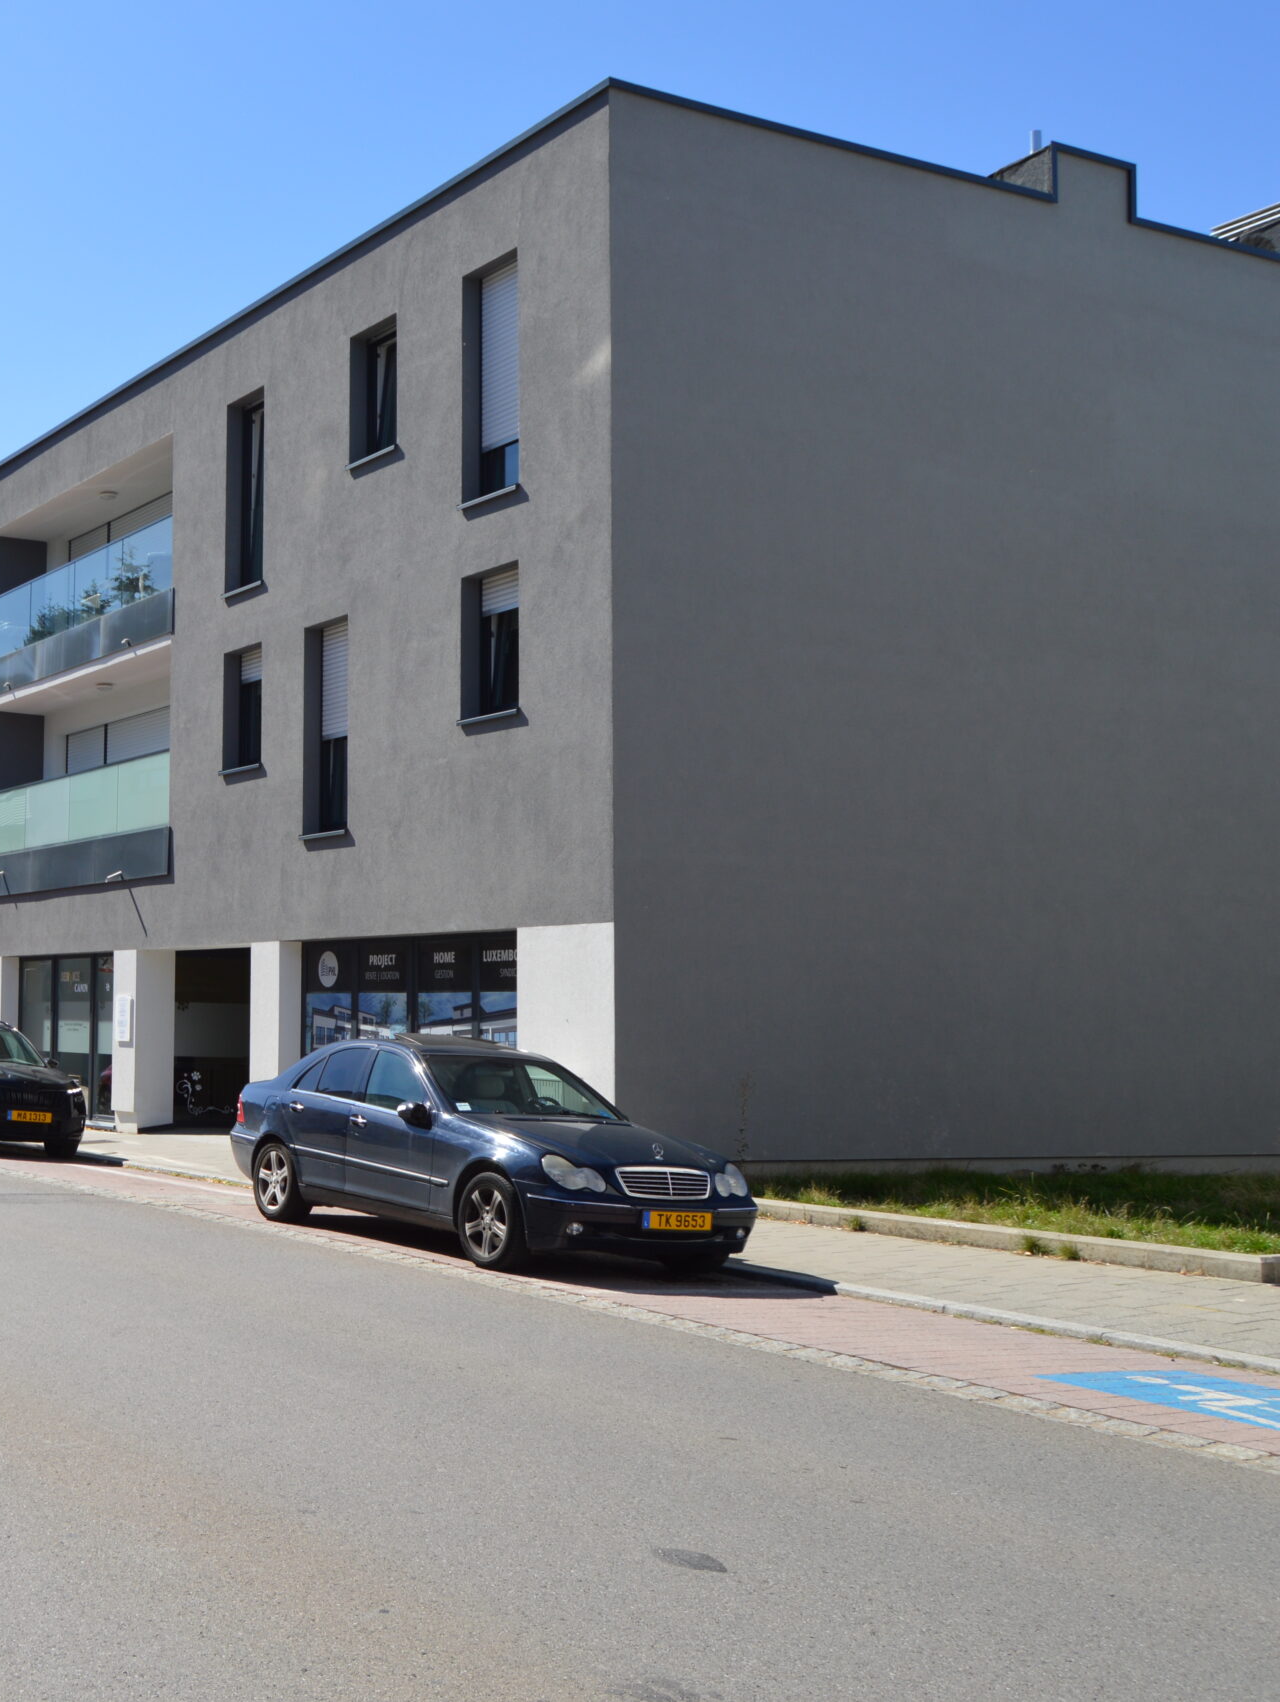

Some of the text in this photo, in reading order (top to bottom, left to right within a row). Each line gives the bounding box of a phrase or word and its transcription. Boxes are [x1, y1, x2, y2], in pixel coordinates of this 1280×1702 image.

[369, 954, 396, 968] PROJECT
[433, 951, 455, 964] HOME
[365, 971, 377, 980] VENTE
[381, 971, 400, 980] LOCATION
[434, 969, 454, 979] GESTION
[657, 1213, 673, 1227] TK
[675, 1214, 706, 1228] 9653
